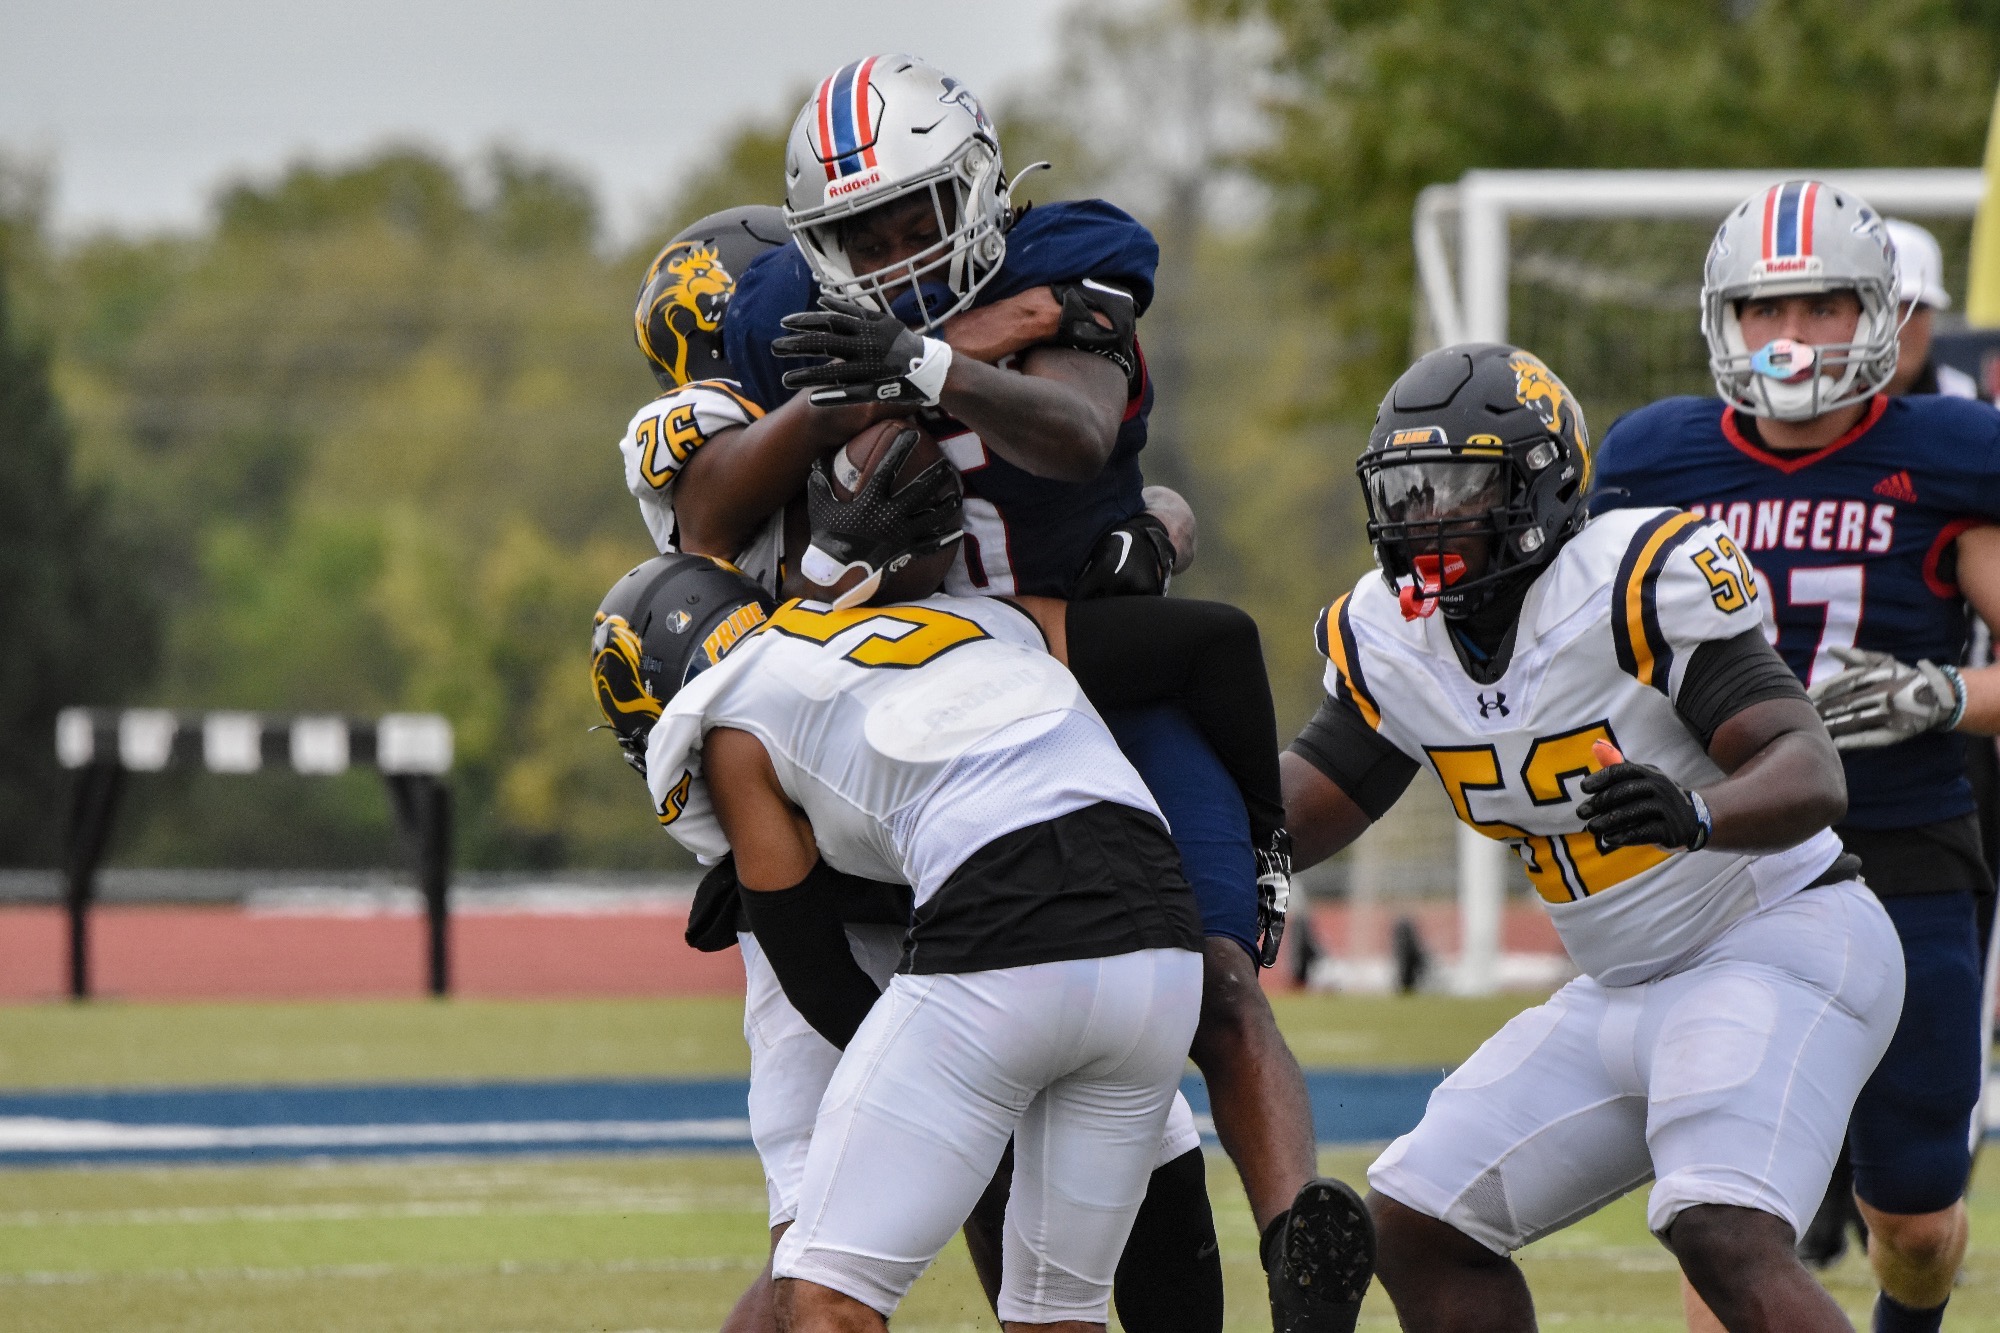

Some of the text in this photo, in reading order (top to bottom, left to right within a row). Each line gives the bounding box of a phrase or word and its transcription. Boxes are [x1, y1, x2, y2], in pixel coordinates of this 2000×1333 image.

[829, 173, 880, 198] Riddell
[1766, 259, 1806, 273] Riddell
[635, 402, 709, 490] 26
[1690, 499, 1895, 553] ONEERS
[1690, 533, 1758, 616] 52
[701, 600, 768, 667] PRIDE
[752, 597, 995, 670] 5
[1421, 717, 1674, 904] 52
